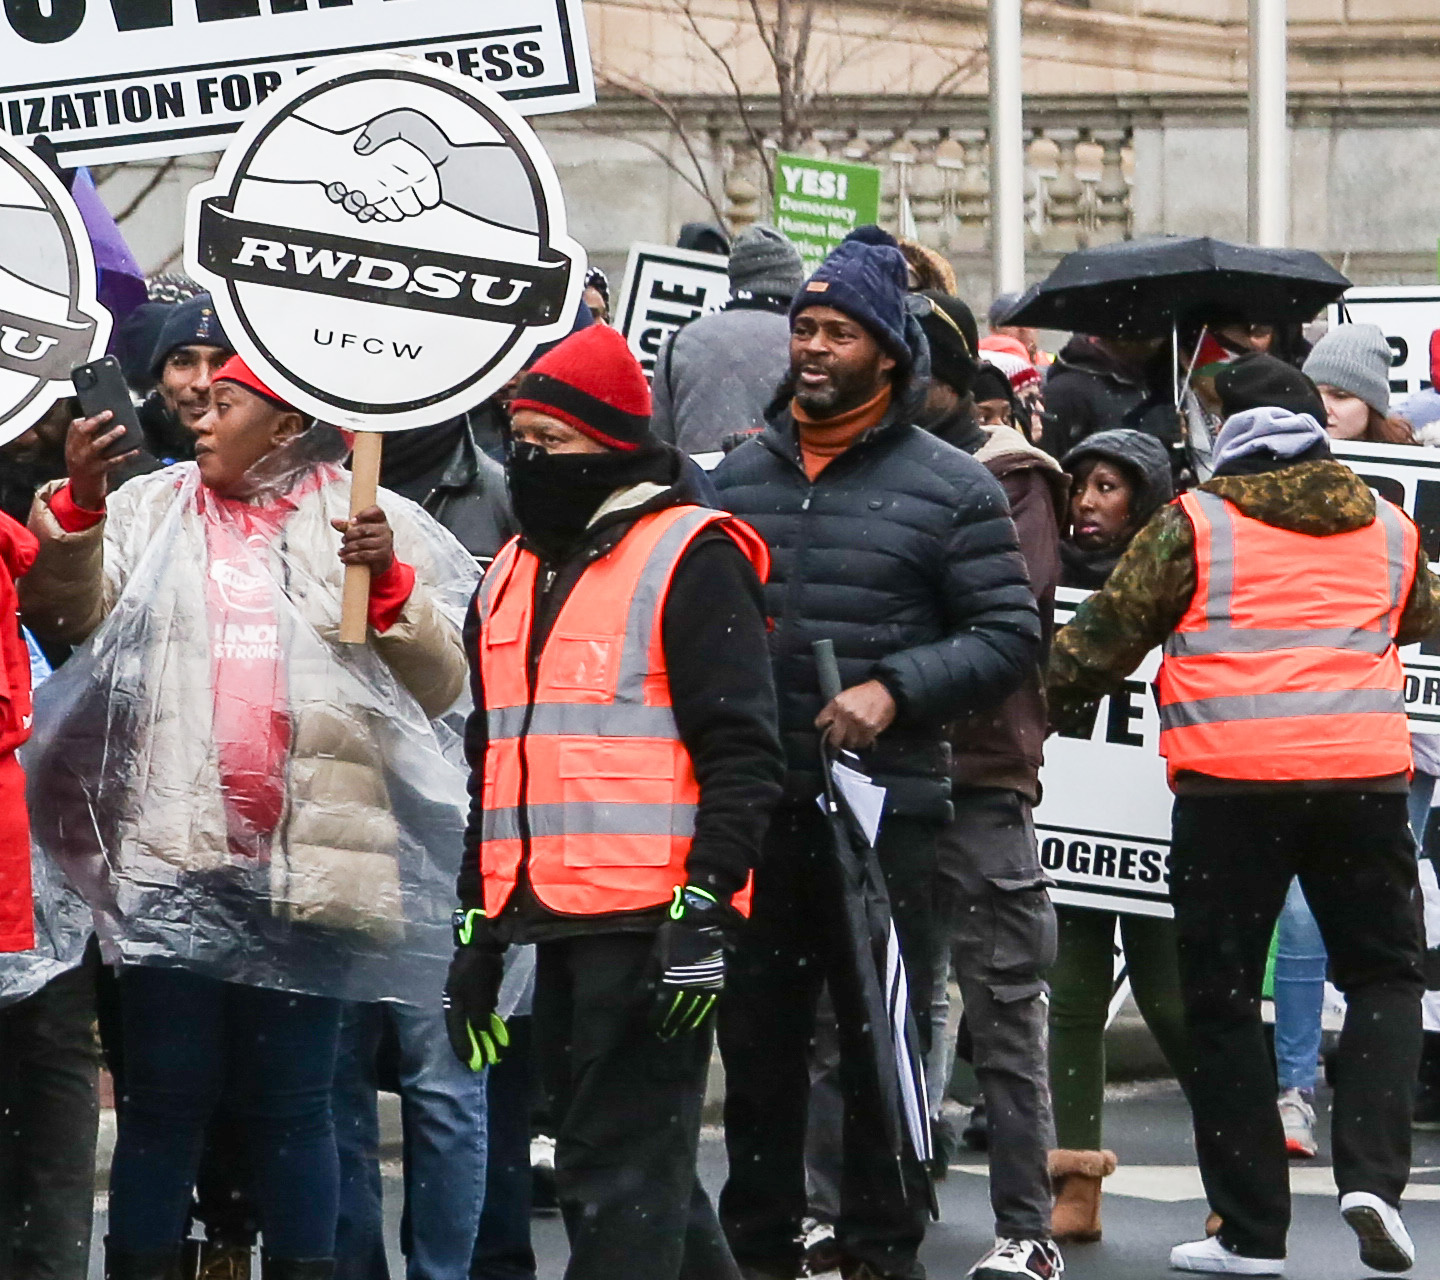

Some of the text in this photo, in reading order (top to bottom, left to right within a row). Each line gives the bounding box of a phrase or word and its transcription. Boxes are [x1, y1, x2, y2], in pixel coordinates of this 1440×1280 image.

[781, 165, 848, 201] YES!
[232, 236, 532, 308] RWDSU
[313, 328, 424, 360] UFCW
[1041, 837, 1170, 884] OGRES
